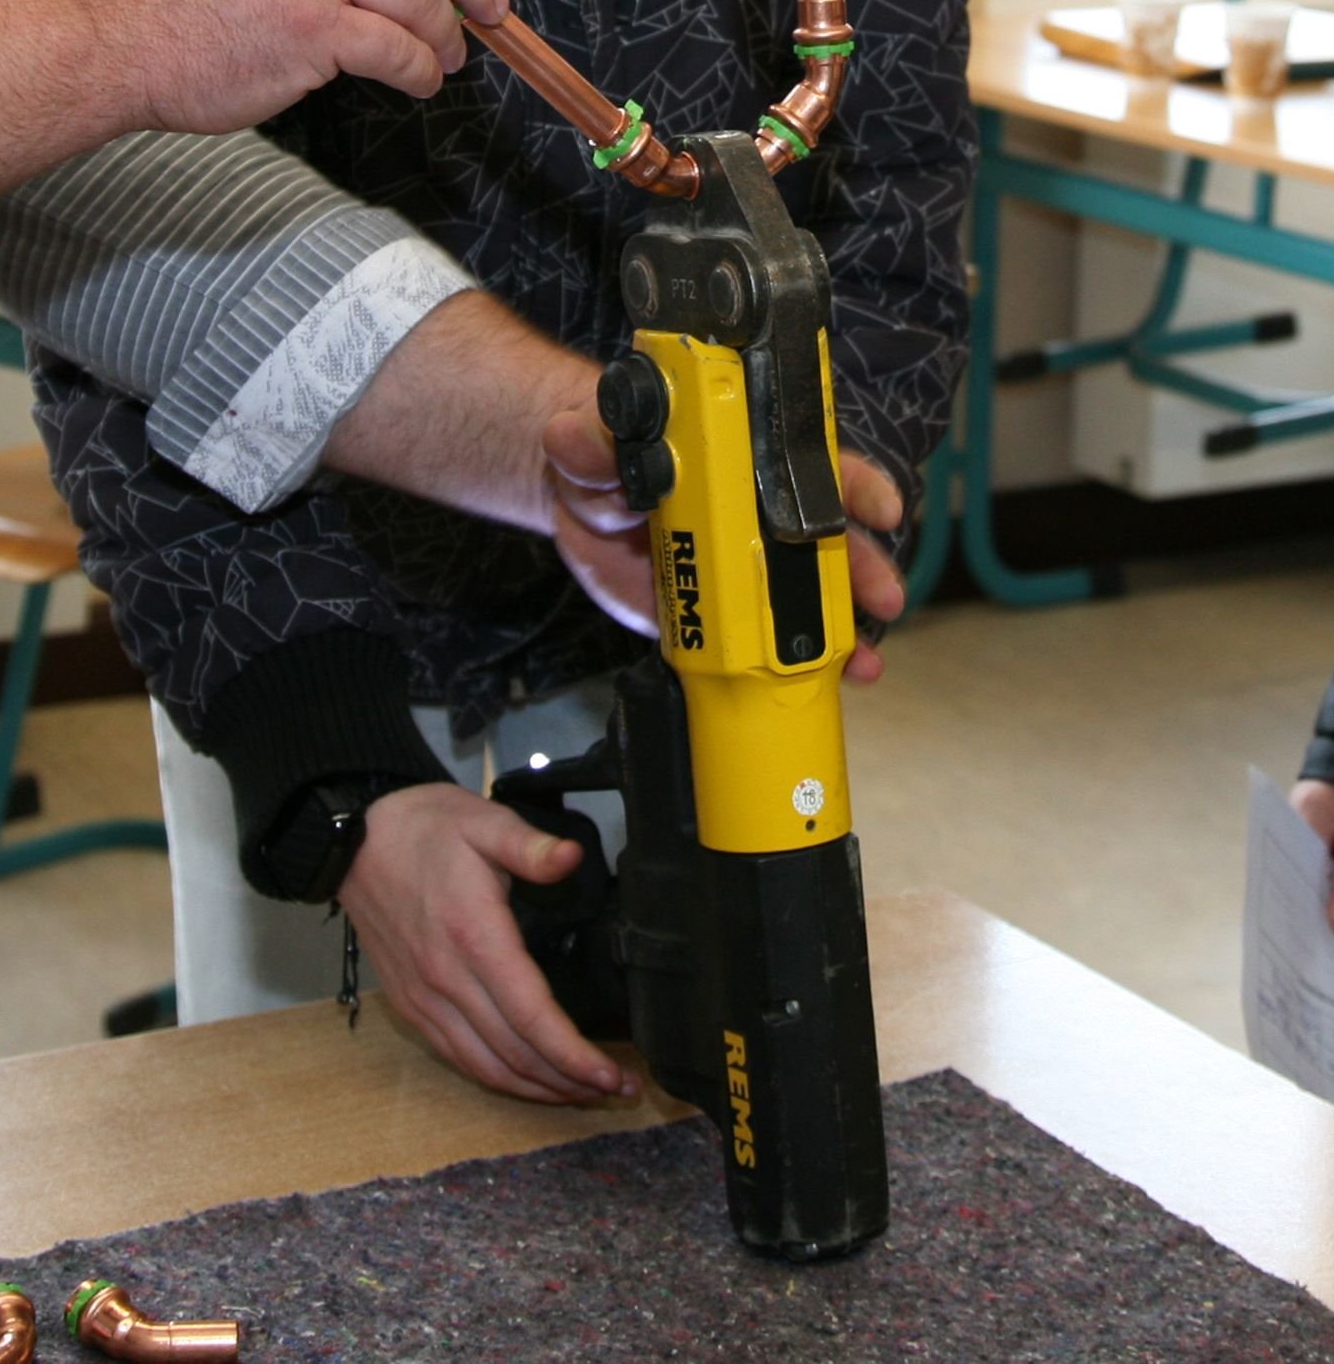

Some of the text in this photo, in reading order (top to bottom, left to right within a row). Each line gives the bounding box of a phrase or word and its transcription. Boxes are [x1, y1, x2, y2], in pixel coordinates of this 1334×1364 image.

[670, 278, 697, 299] PT2
[671, 530, 704, 650] REMS
[723, 1029, 756, 1169] REMS
